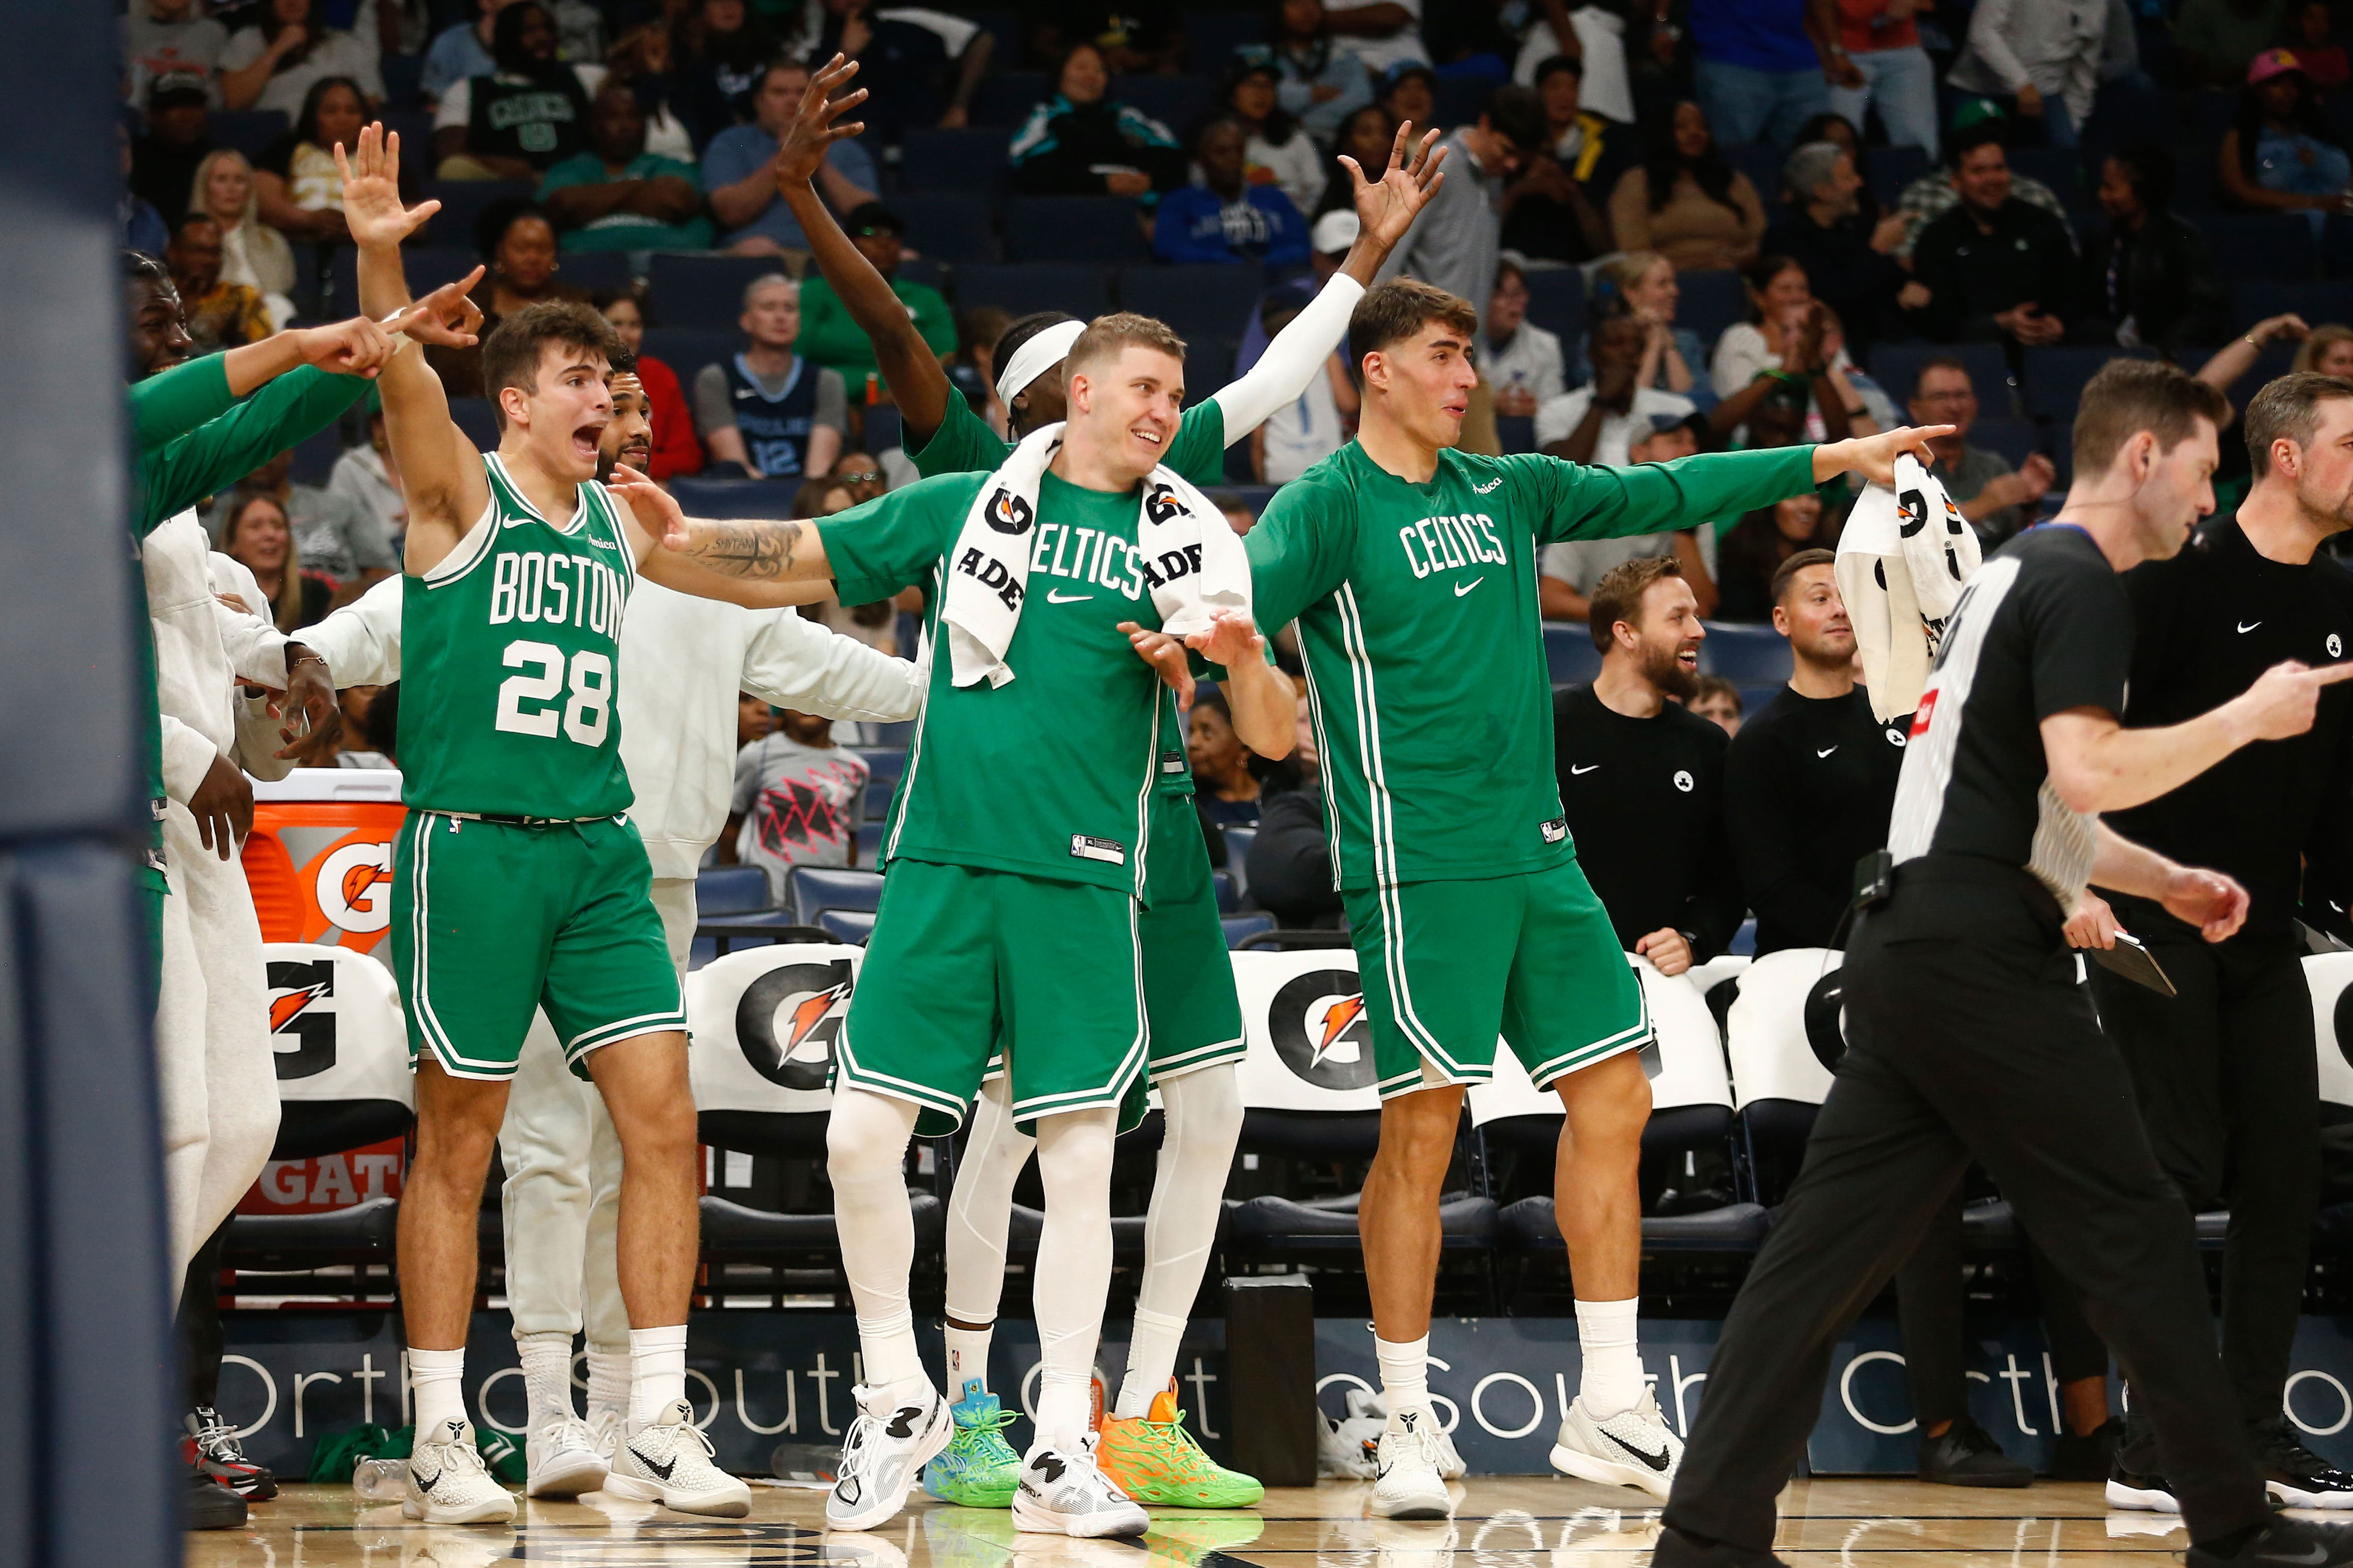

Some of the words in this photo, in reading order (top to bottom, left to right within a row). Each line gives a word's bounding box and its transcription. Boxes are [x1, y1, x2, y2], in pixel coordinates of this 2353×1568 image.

[589, 533, 617, 551] Amica
[1029, 523, 1145, 602] ELTICS
[1399, 513, 1507, 579] CELTICS
[489, 551, 630, 645] BOSTON
[495, 639, 612, 748] 28
[316, 842, 392, 933] G
[735, 959, 853, 1090] G
[259, 1154, 405, 1205] GAT
